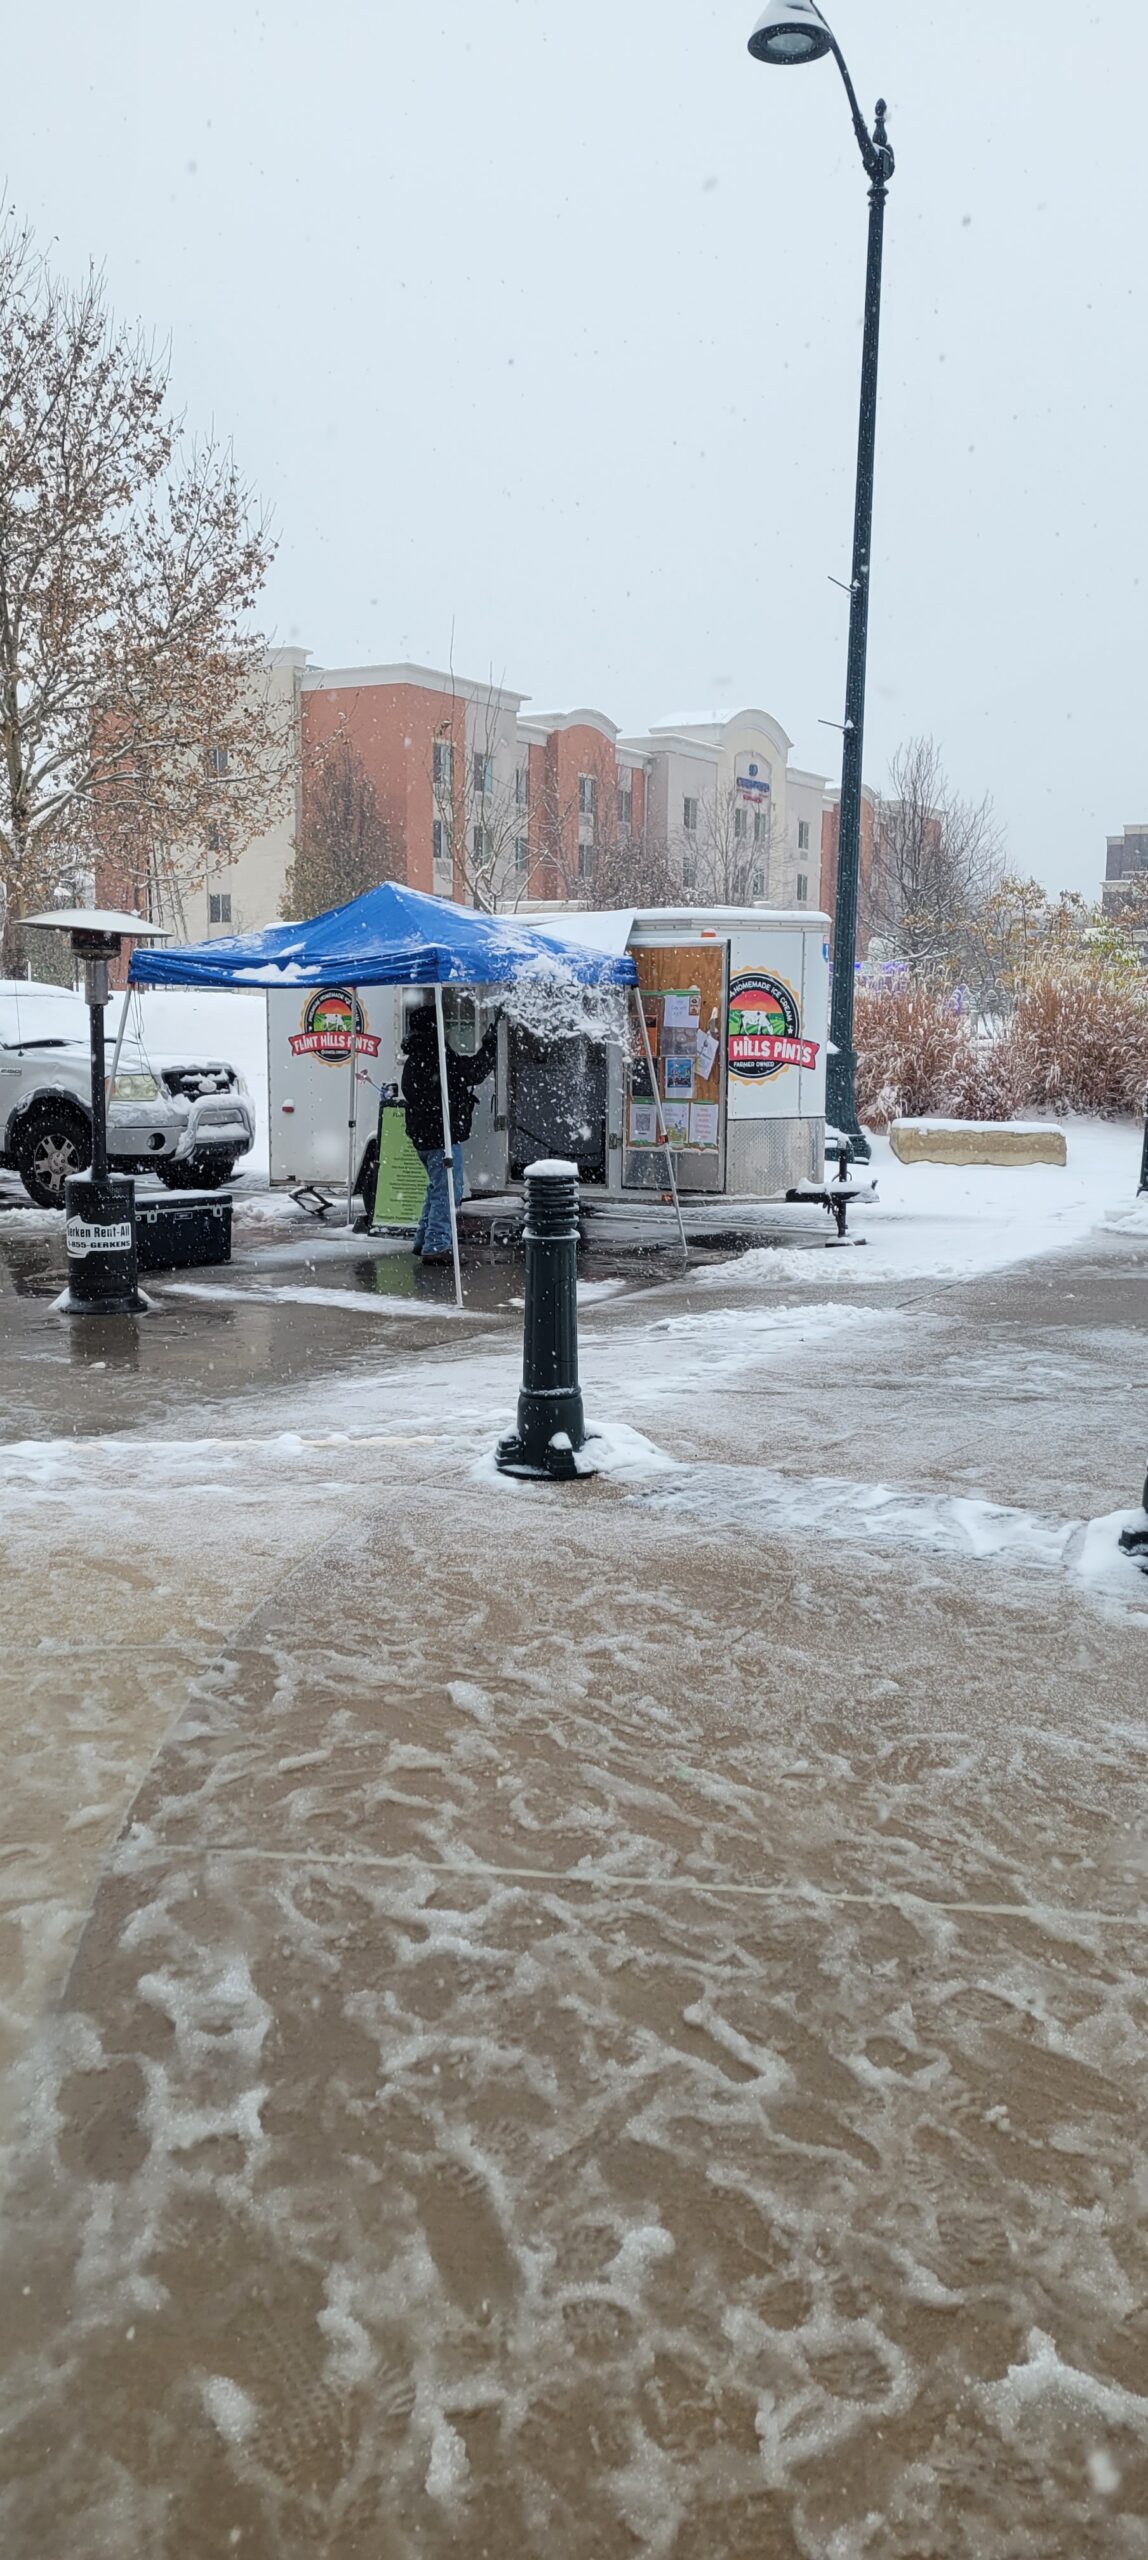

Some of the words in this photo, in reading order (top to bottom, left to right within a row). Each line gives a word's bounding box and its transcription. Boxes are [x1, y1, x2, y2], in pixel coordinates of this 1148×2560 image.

[734, 981, 771, 992] HOMEMADE
[771, 987, 782, 998] ICE
[780, 997, 792, 1022] CREAM
[294, 1035, 318, 1052] FLINT
[320, 1032, 345, 1048] HILLS
[348, 1036, 374, 1052] PNTS
[733, 1036, 770, 1057] HILLS
[774, 1039, 812, 1063] PINTS
[94, 1225, 130, 1238] Rent-All
